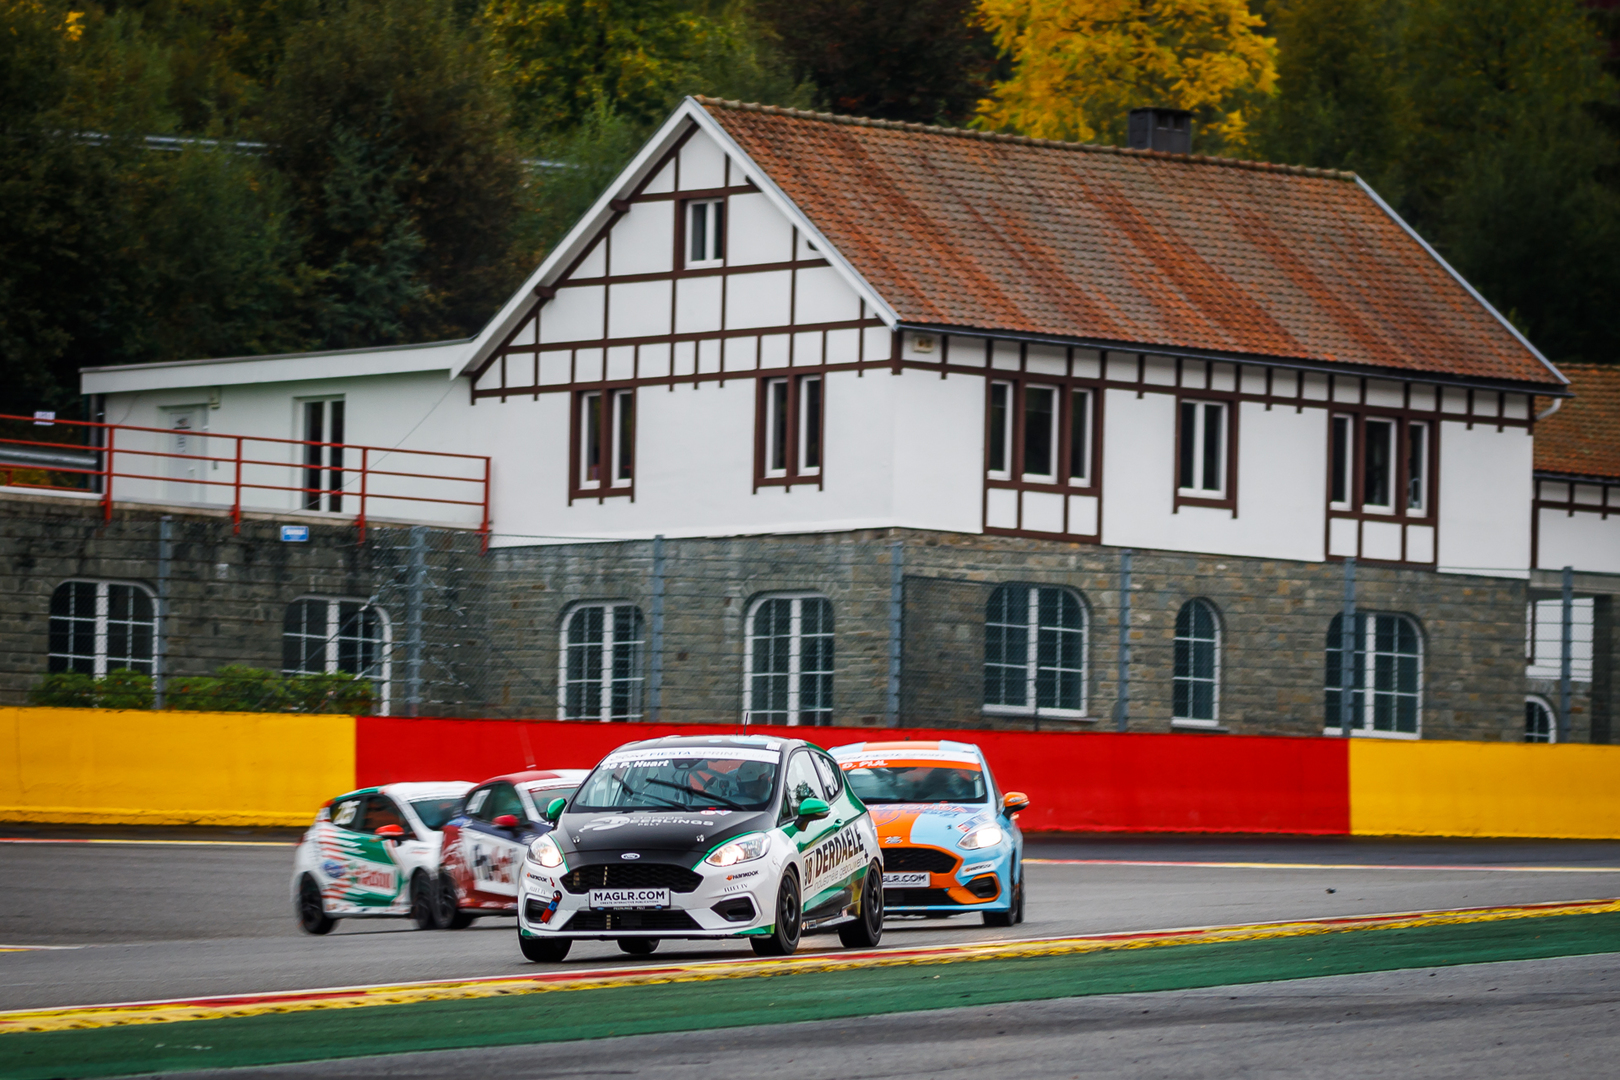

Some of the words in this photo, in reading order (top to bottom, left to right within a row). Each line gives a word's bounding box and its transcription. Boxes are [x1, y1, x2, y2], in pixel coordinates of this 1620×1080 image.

[633, 760, 669, 768] Huart
[815, 827, 864, 878] DERDAELE
[882, 874, 927, 883] GLR.COM
[594, 890, 665, 901] MAGLR.COM
